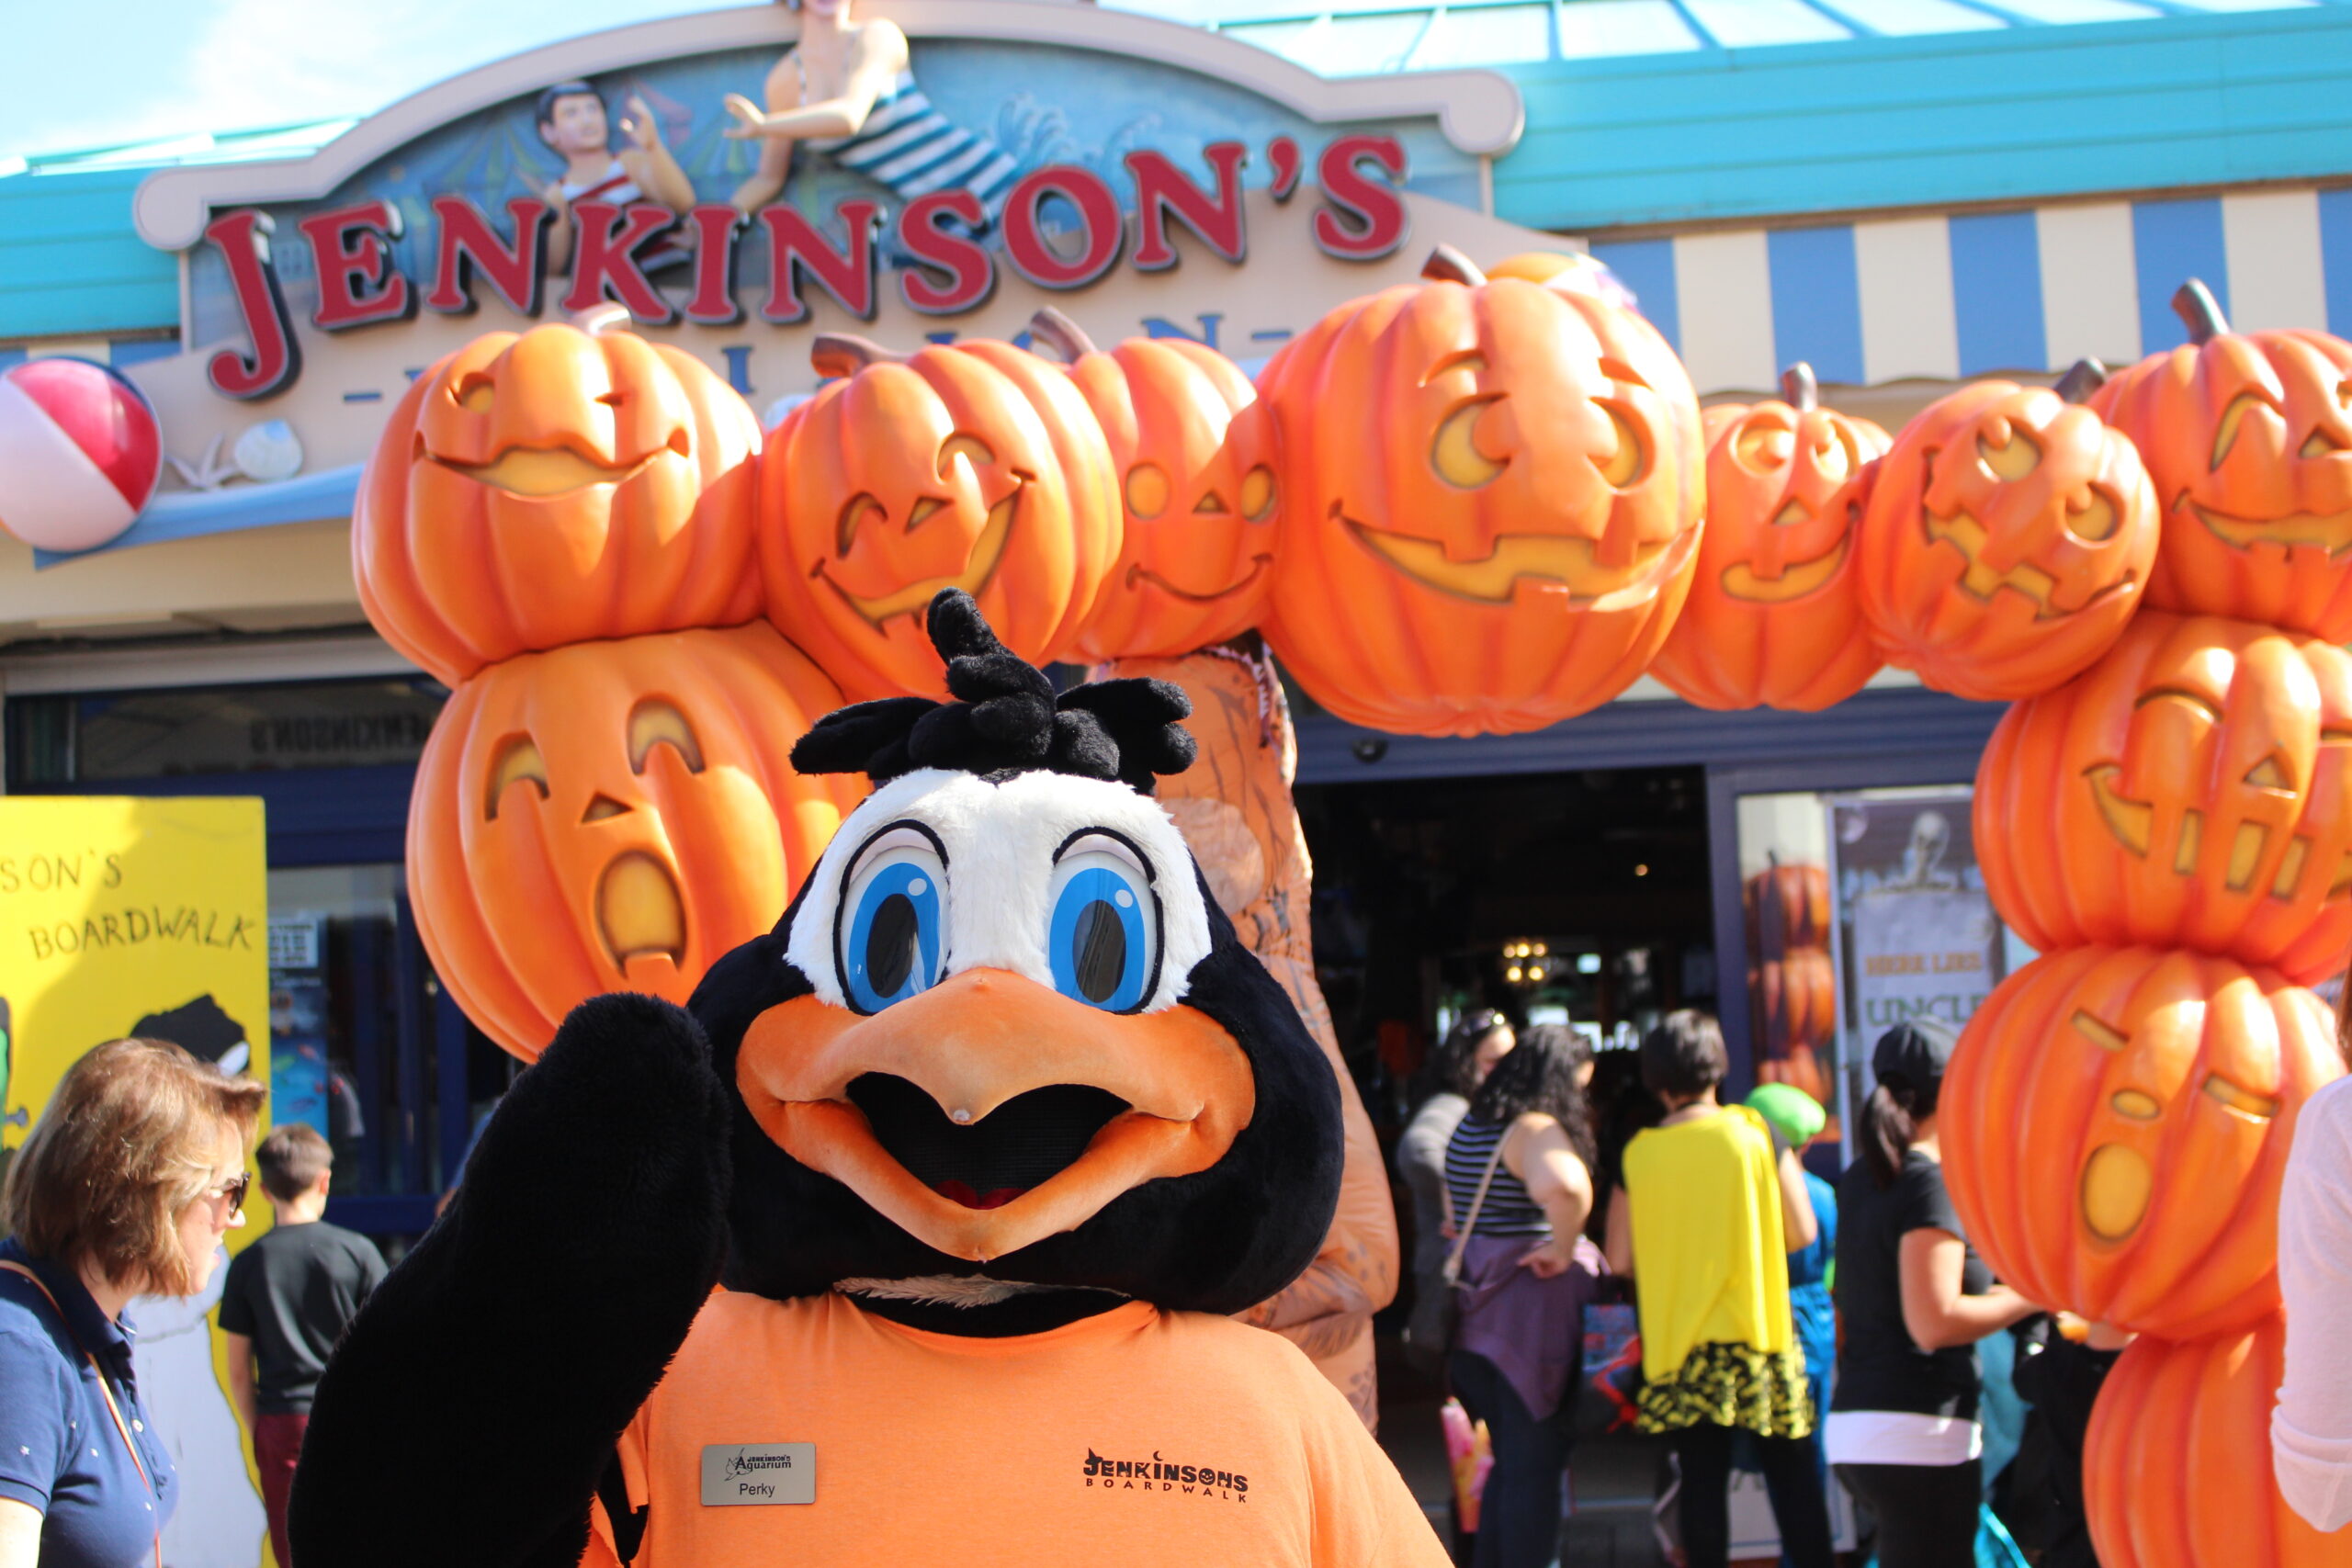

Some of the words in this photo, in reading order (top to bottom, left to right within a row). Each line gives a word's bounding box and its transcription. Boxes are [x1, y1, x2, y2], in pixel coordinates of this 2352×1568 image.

[204, 135, 1409, 401] JENKINSON'S
[28, 904, 256, 960] BOARDWALK
[1866, 953, 1926, 976] HERE
[1931, 951, 1982, 974] LIES
[735, 1456, 792, 1472] Aquarium
[747, 1454, 792, 1462] JENKINSON'S
[1083, 1455, 1249, 1493] JENKINSONS
[740, 1483, 775, 1498] Perky
[1086, 1478, 1246, 1503] BOARDWALK
